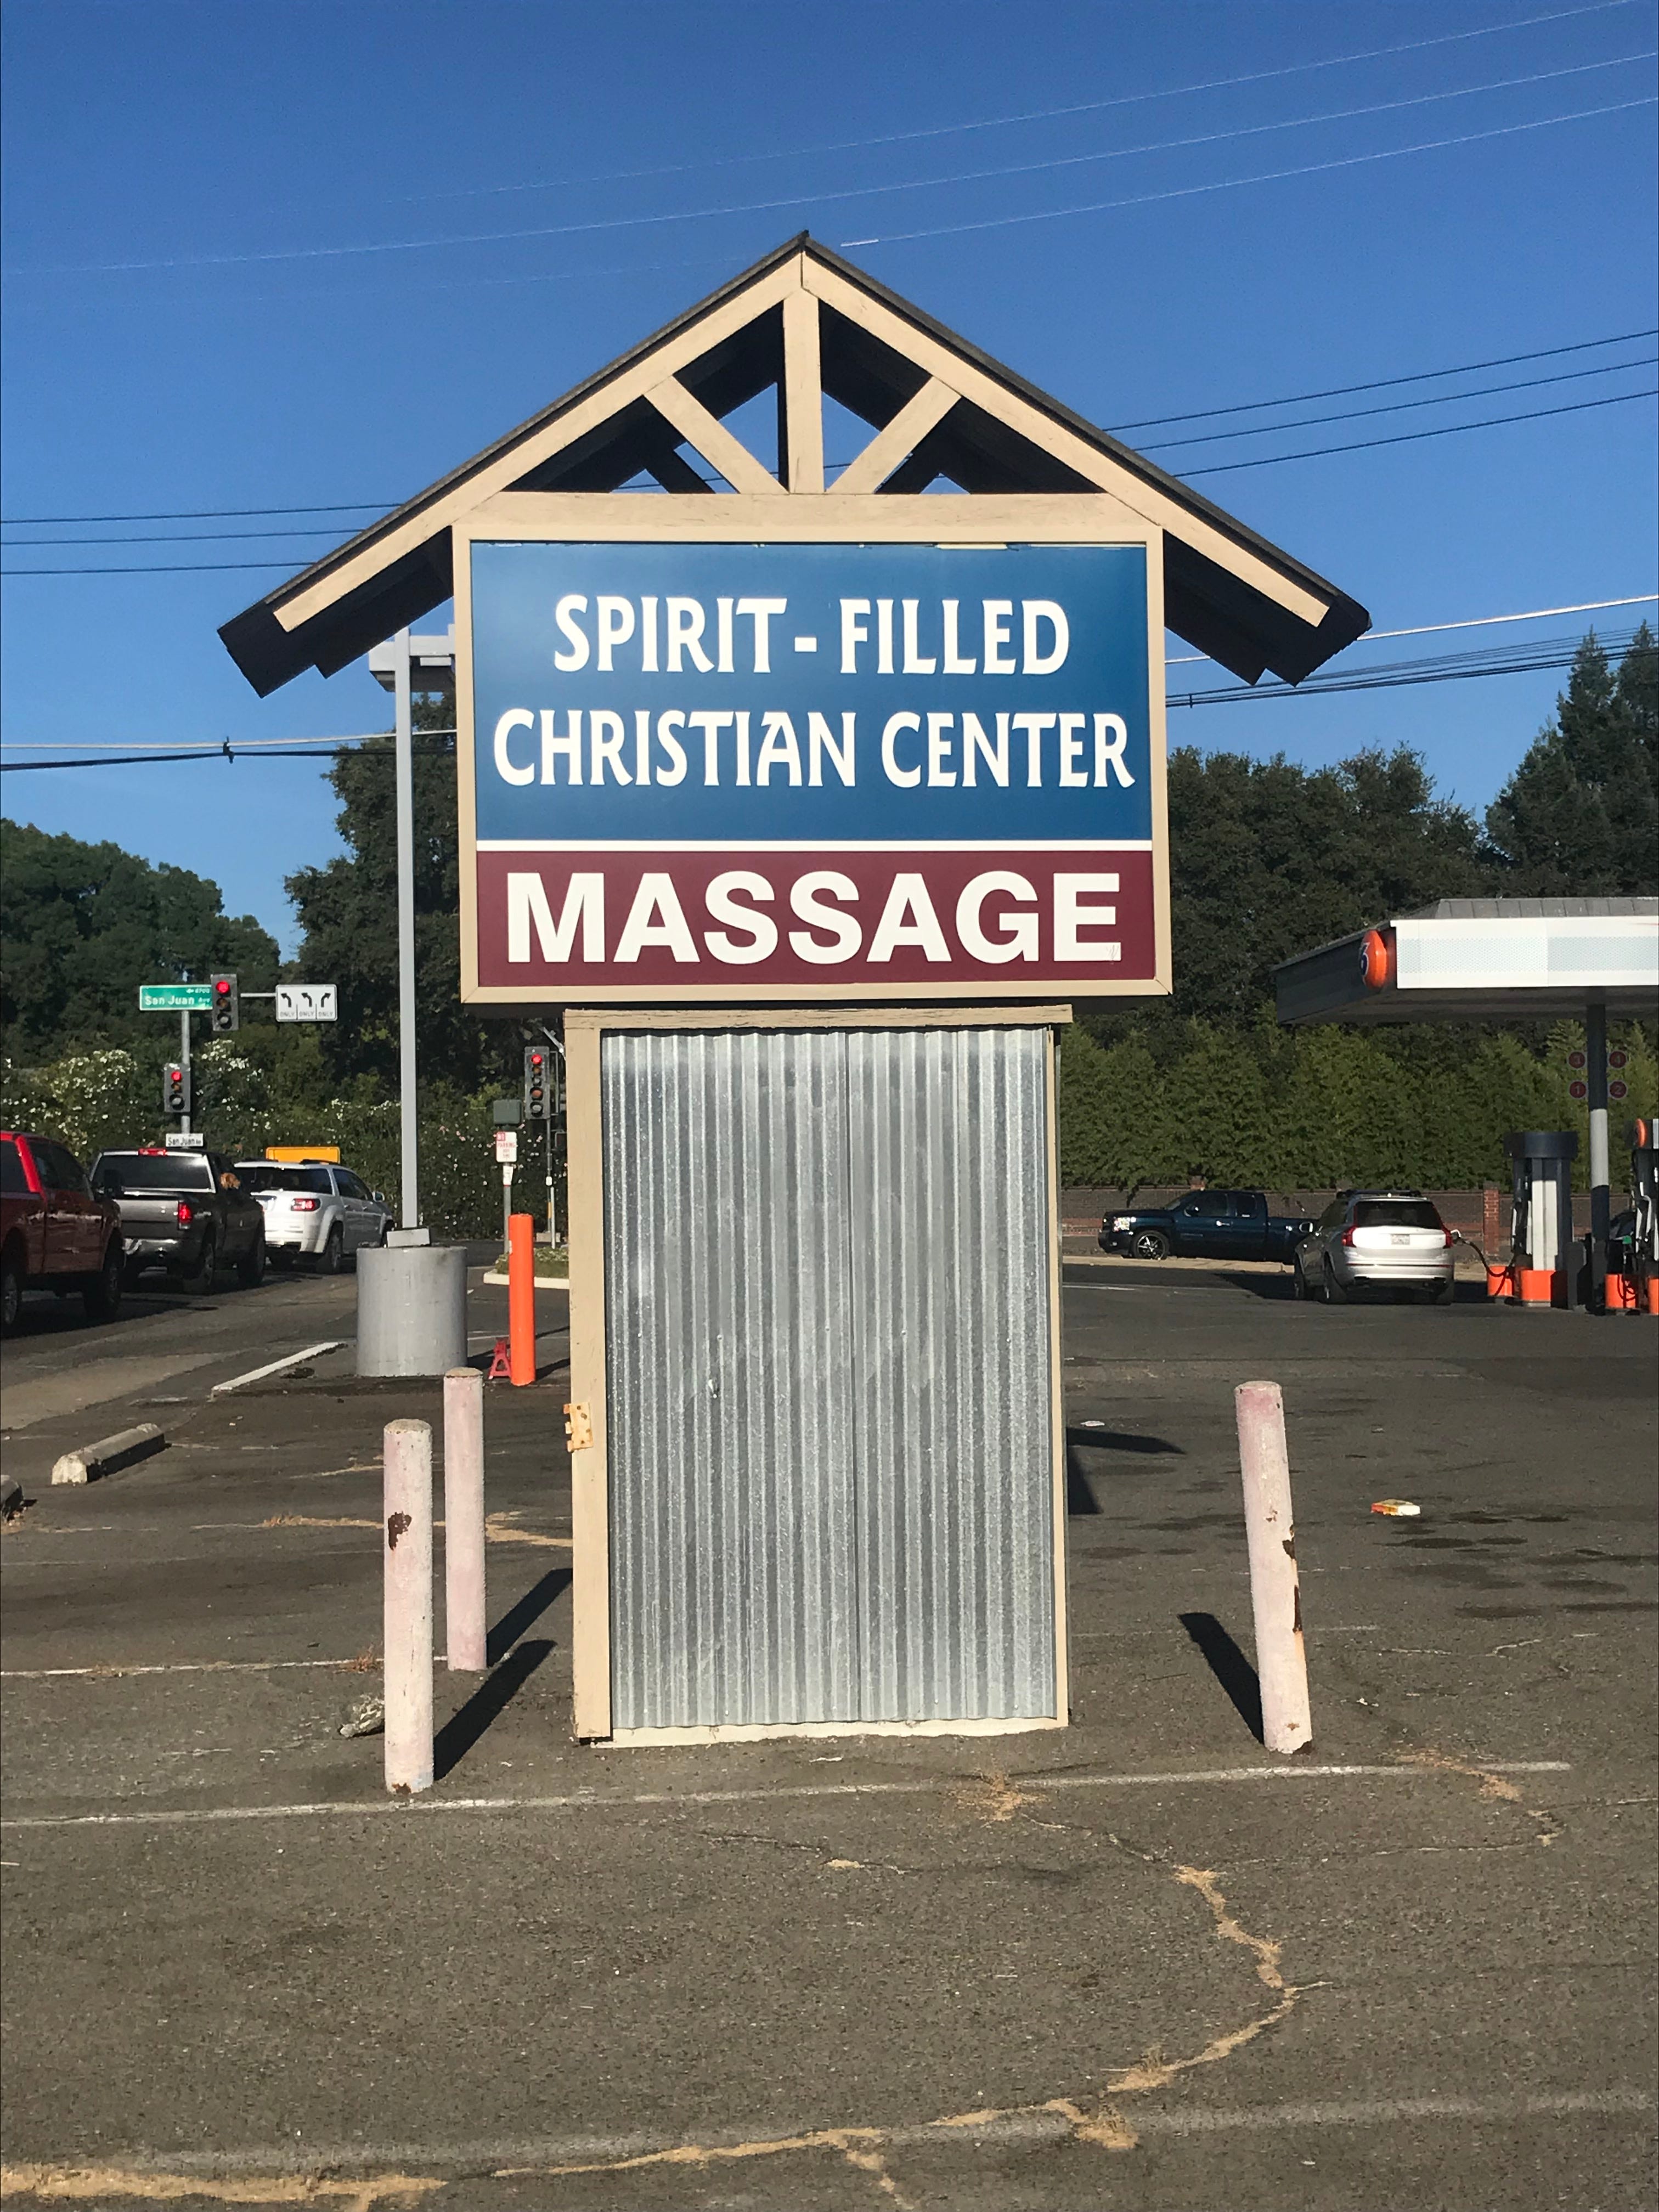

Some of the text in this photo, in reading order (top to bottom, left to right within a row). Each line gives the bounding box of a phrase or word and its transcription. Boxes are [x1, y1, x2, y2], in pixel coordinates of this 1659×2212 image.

[839, 599, 1069, 675] FILLED
[493, 708, 1136, 788] CHRISTIAN CENTER
[507, 870, 1122, 964] MASSAGE
[145, 995, 165, 1006] San
[167, 995, 195, 1005] Juan
